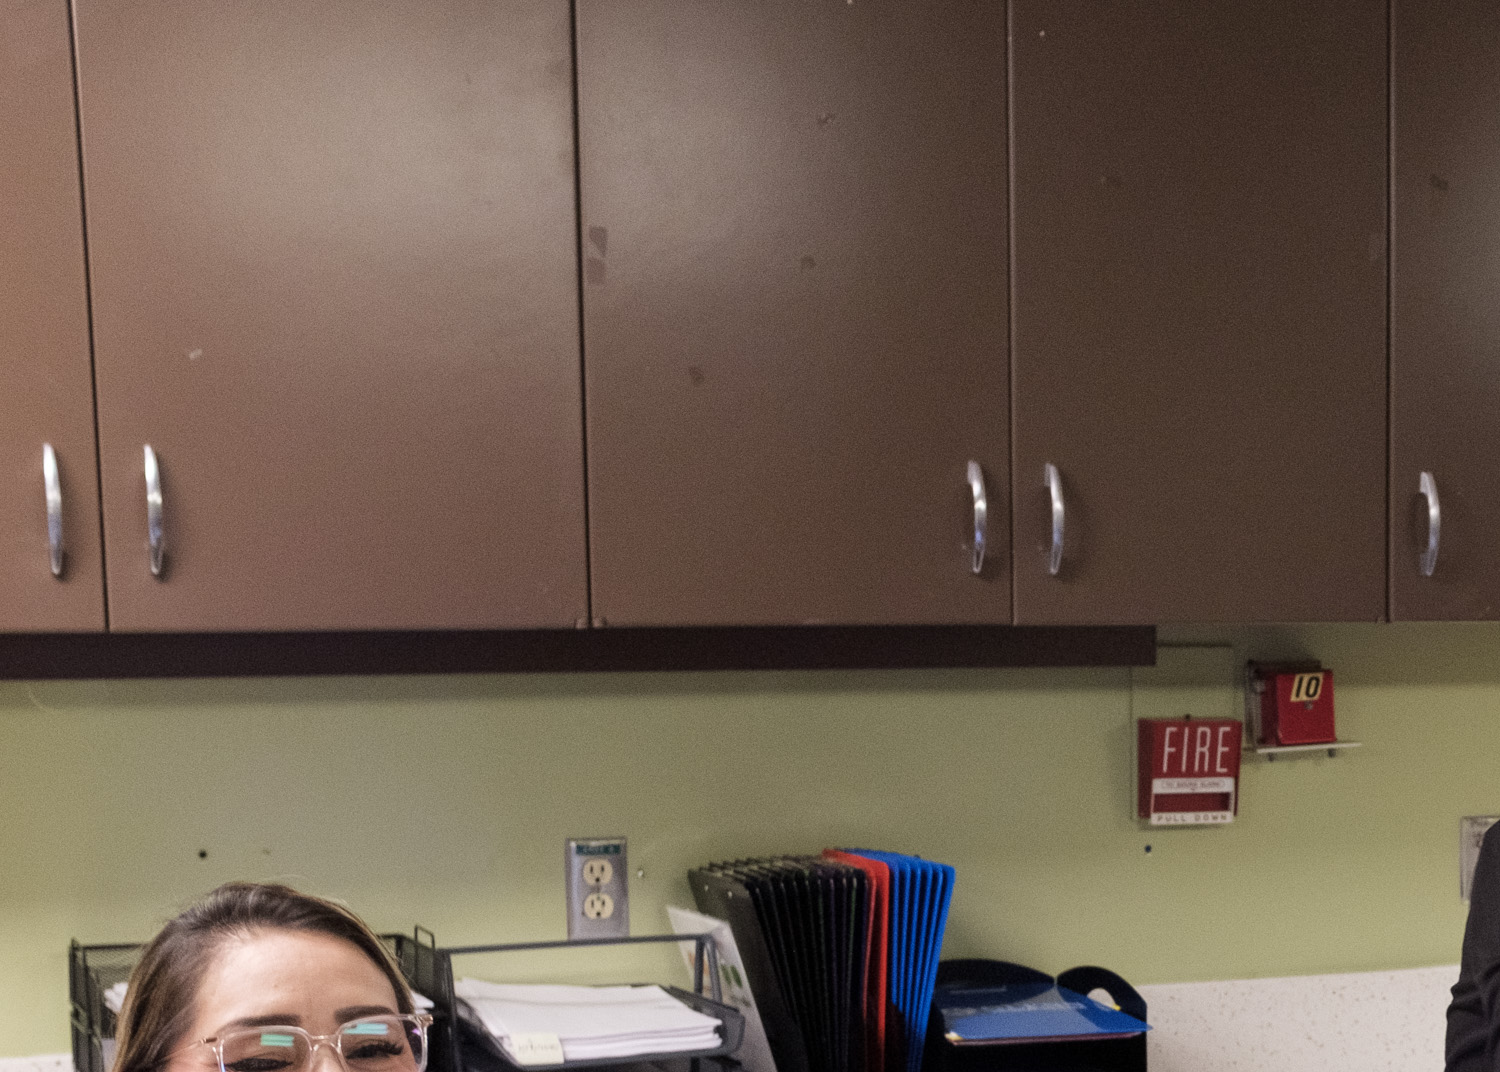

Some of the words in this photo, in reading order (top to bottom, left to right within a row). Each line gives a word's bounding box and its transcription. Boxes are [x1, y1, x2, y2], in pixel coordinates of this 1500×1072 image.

[1294, 675, 1321, 698] 10
[1162, 726, 1231, 773] FIRE
[1157, 814, 1186, 822] PULL
